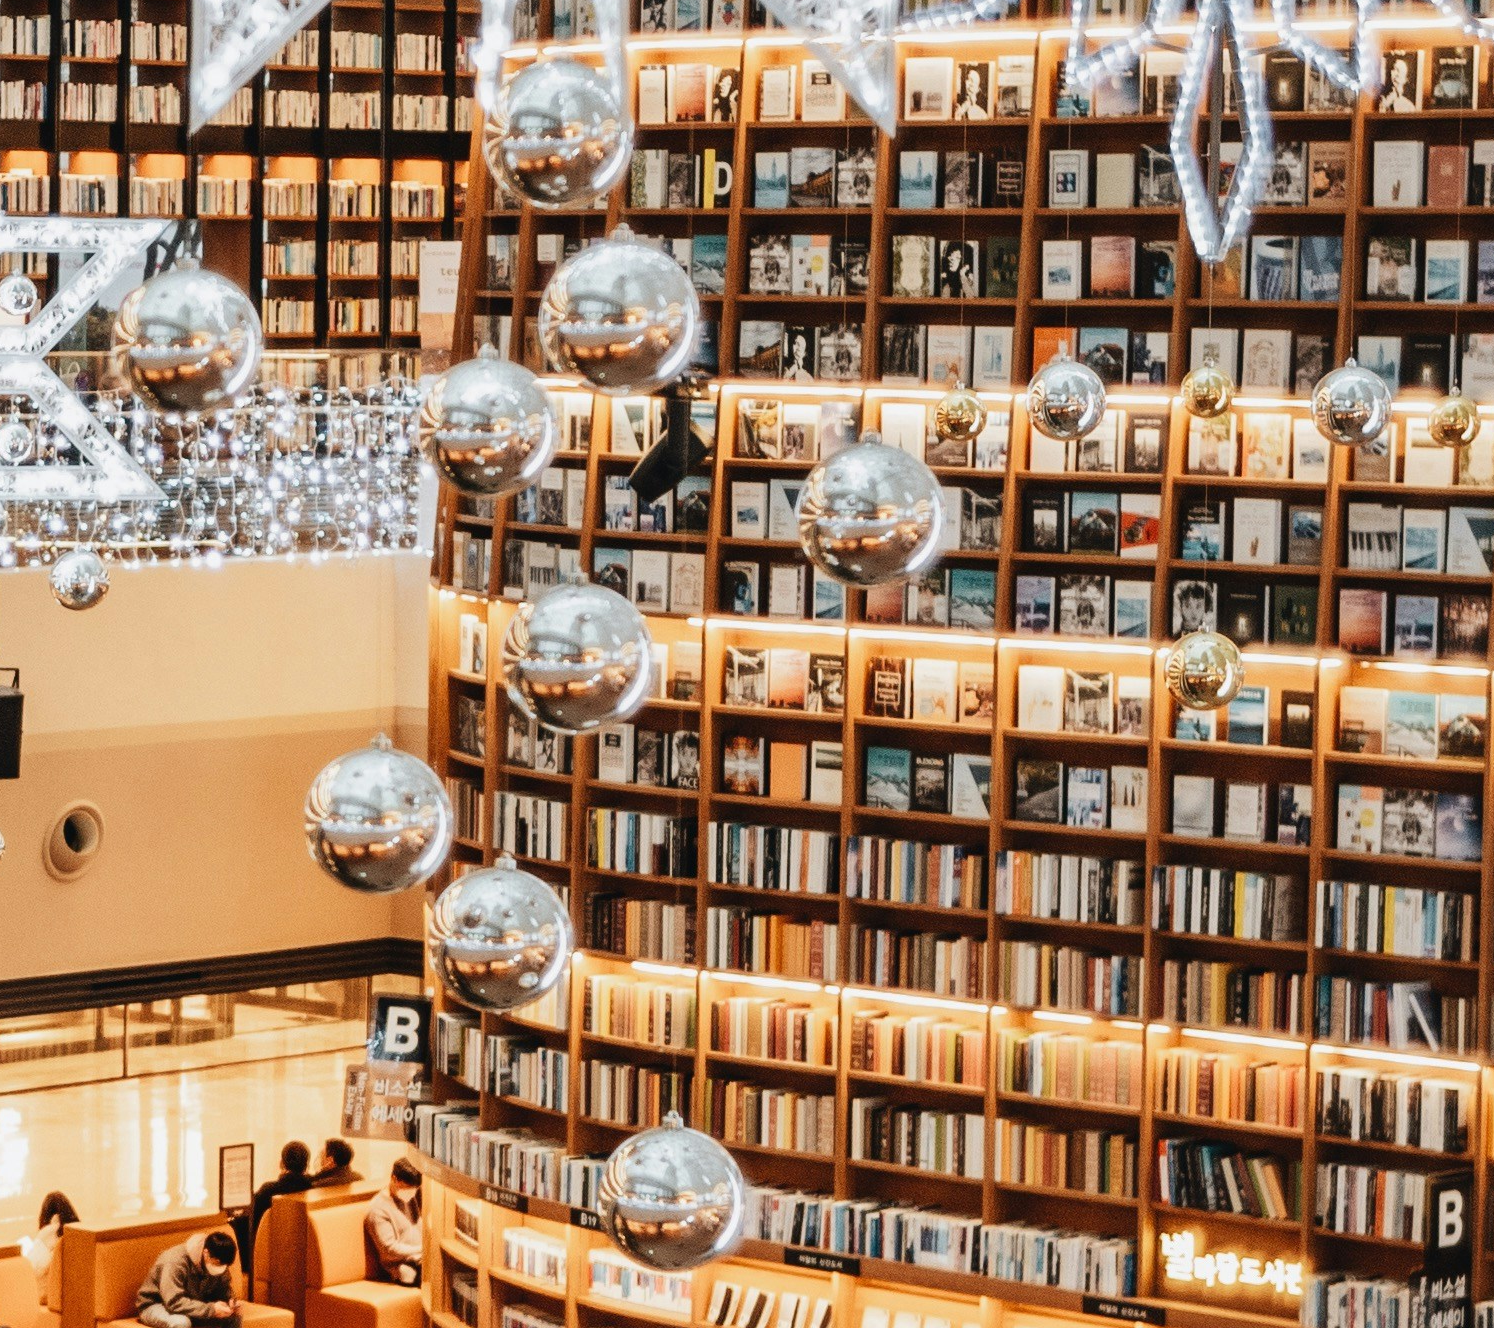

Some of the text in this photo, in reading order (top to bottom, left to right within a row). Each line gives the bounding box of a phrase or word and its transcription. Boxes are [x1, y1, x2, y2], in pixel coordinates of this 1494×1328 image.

[678, 776, 698, 789] FACE
[383, 1005, 420, 1054] B
[580, 1211, 598, 1227] B19
[1438, 1188, 1463, 1249] B
[1430, 1274, 1466, 1300] 비소설
